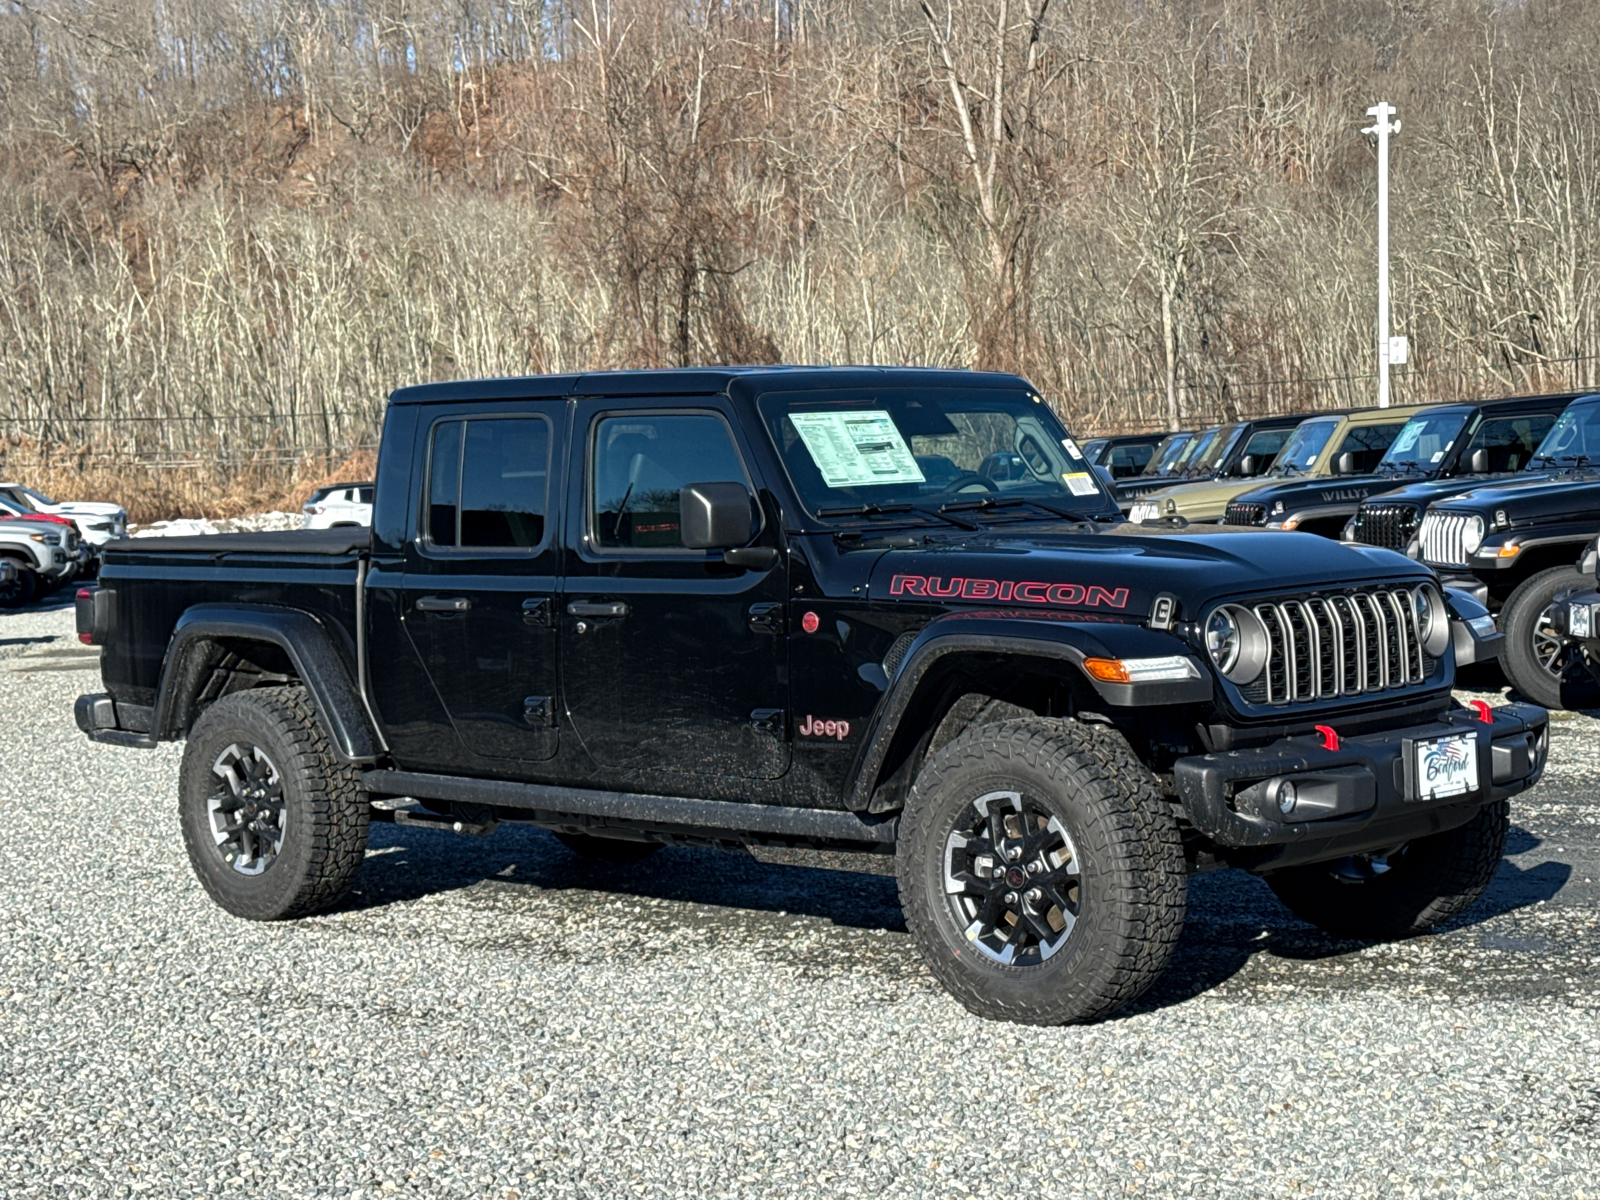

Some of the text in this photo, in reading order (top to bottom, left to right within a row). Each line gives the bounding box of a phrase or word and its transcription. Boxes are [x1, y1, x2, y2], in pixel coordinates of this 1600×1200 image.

[1124, 487, 1155, 498] WILLY
[1321, 487, 1369, 502] WILLYS
[889, 574, 1130, 608] RUBICON
[799, 714, 849, 741] Jeep
[804, 741, 851, 750] GLADIATOR
[1424, 750, 1470, 782] Bedford
